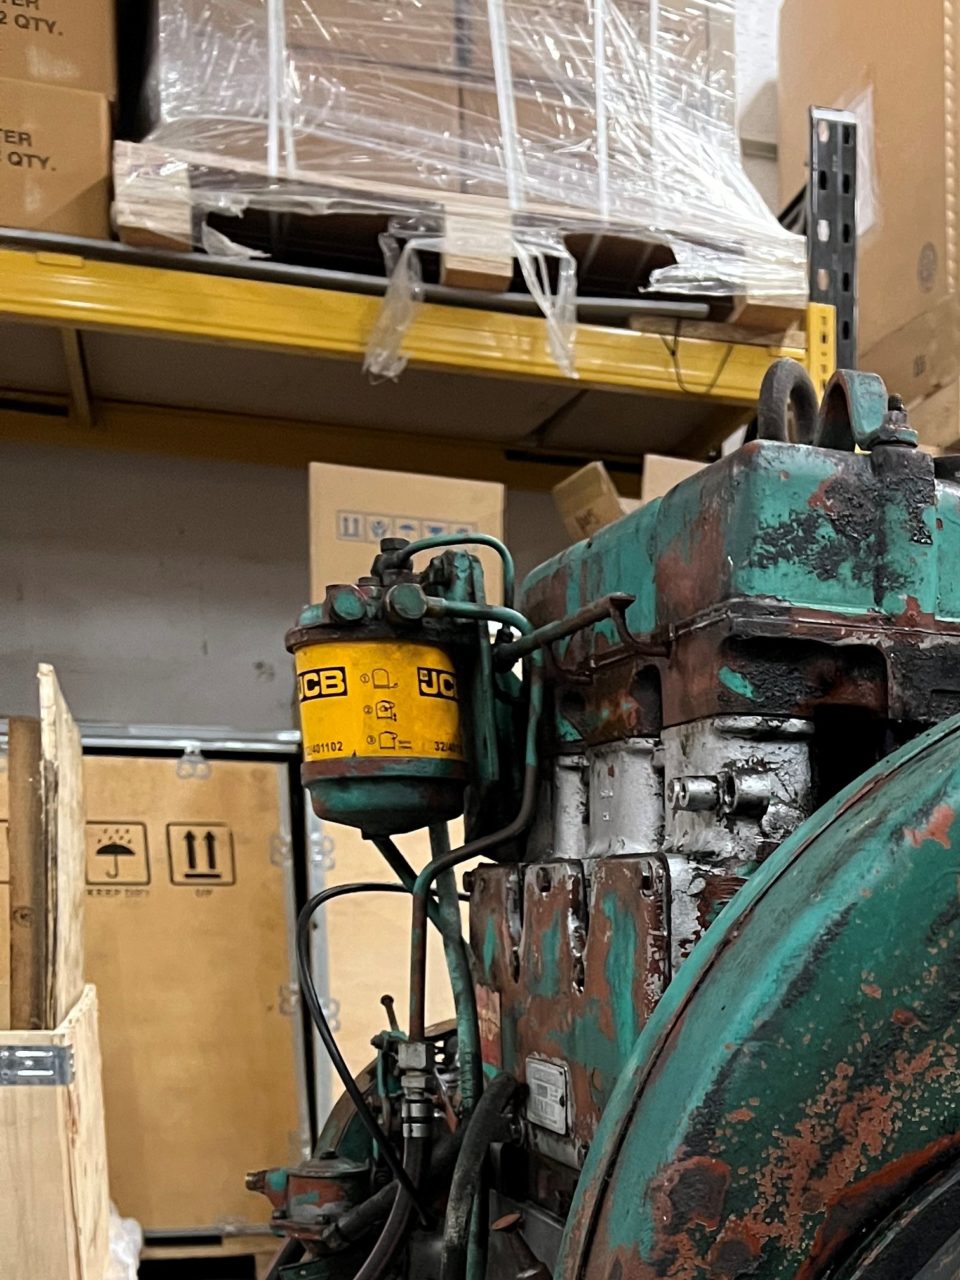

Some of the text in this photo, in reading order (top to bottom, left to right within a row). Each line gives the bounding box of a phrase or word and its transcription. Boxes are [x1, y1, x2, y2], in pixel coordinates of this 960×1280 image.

[14, 13, 63, 36] QTY.
[7, 151, 56, 171] QTY.
[420, 671, 457, 697] JC
